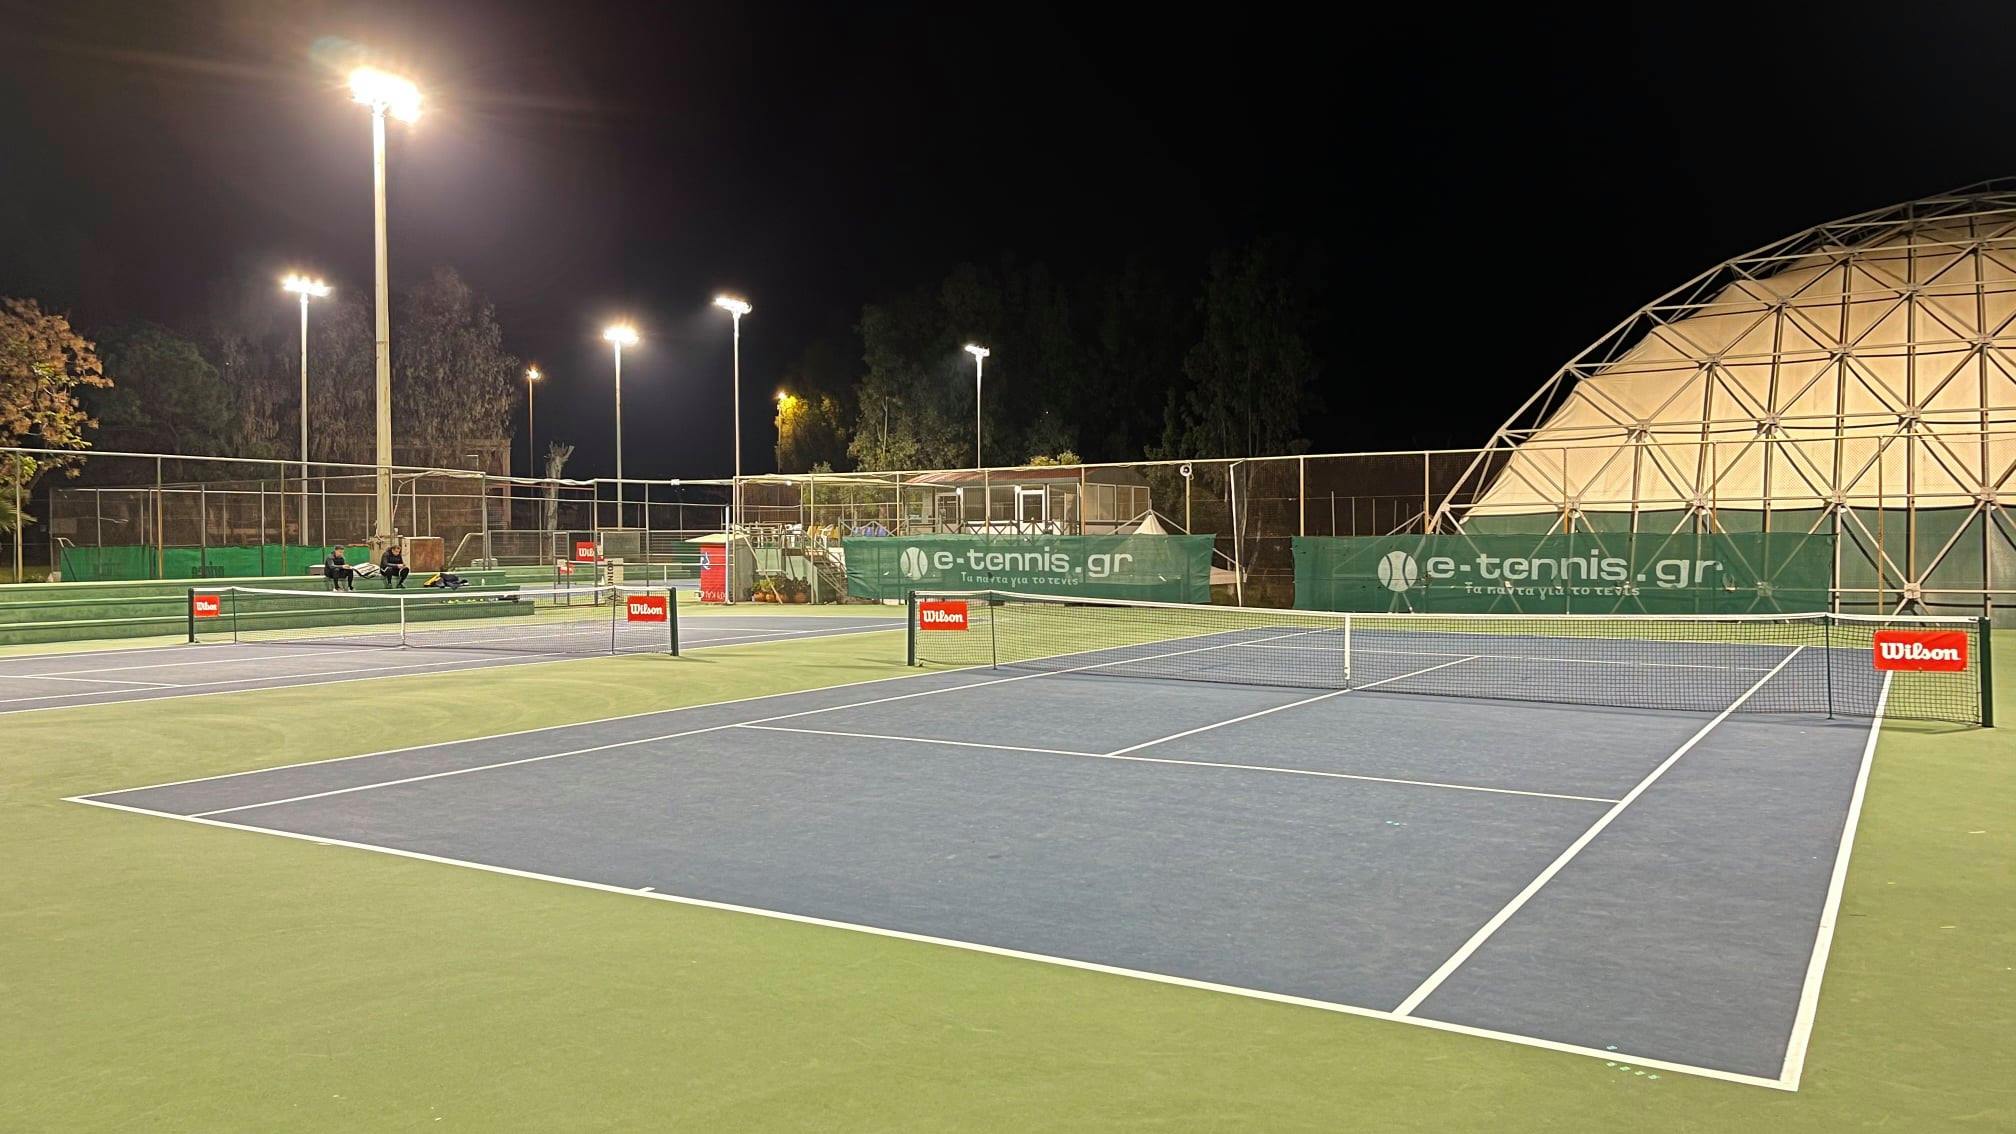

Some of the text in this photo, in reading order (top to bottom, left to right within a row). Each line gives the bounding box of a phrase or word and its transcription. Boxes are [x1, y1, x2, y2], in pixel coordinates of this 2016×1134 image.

[933, 546, 1132, 578] e-tennis.gr
[1427, 549, 1724, 588] e-tennis.gr
[630, 603, 664, 615] Wilson
[923, 609, 965, 623] Wilson
[1880, 642, 1962, 661] Wilson
